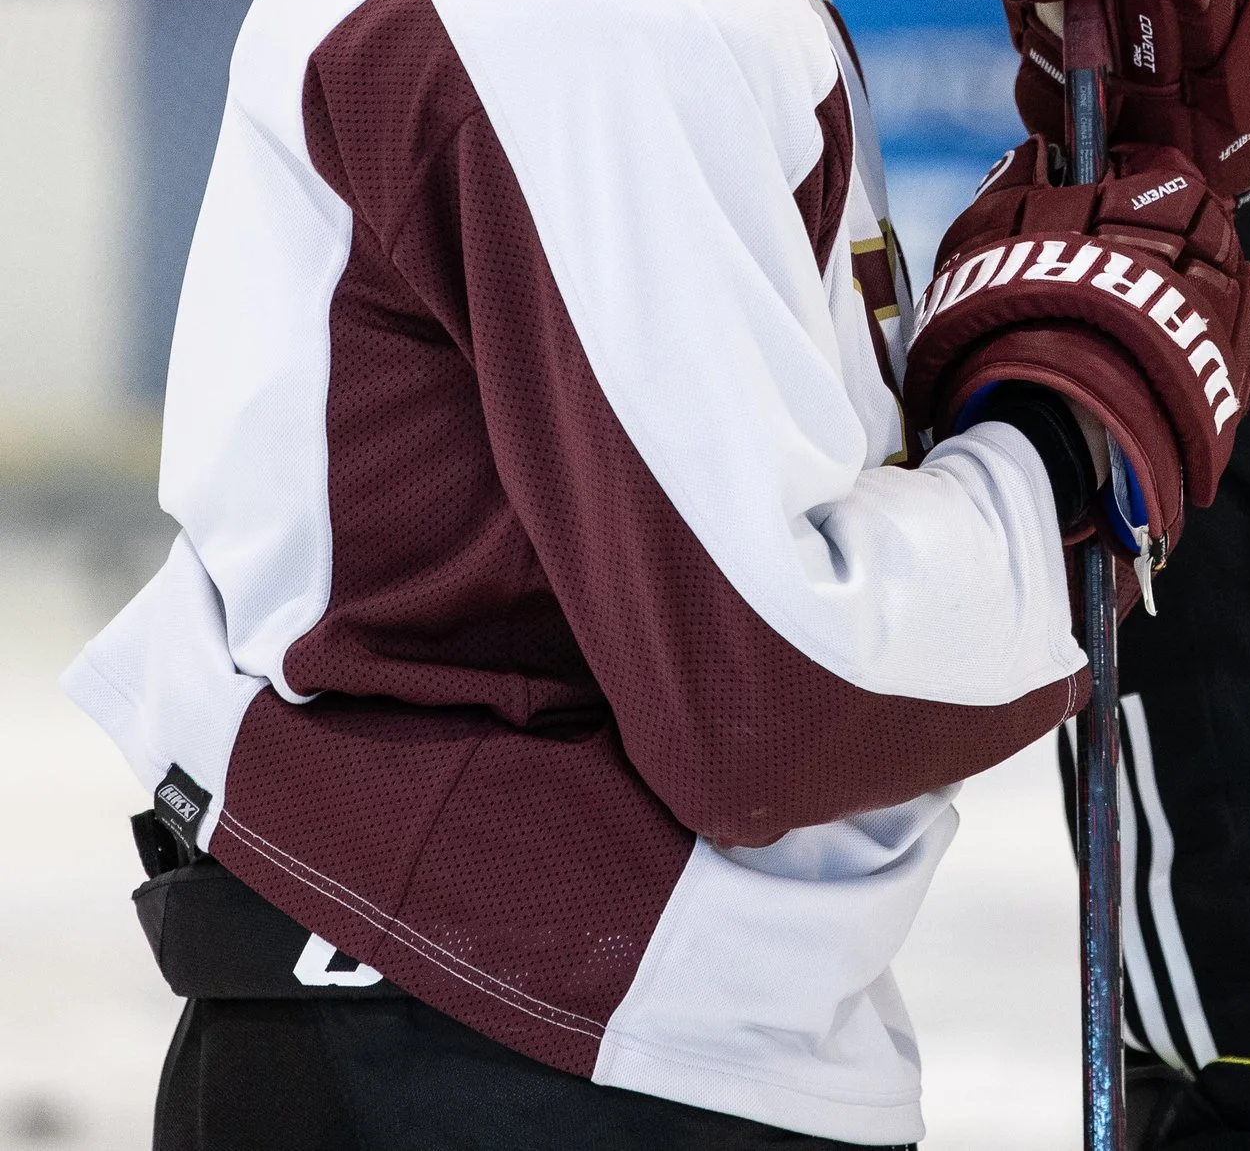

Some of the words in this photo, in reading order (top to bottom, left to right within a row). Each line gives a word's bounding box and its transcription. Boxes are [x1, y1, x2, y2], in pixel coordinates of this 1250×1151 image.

[1133, 44, 1142, 68] PRO
[1139, 14, 1156, 73] COVERT
[1131, 176, 1189, 210] COVERT
[160, 786, 196, 818] HKX
